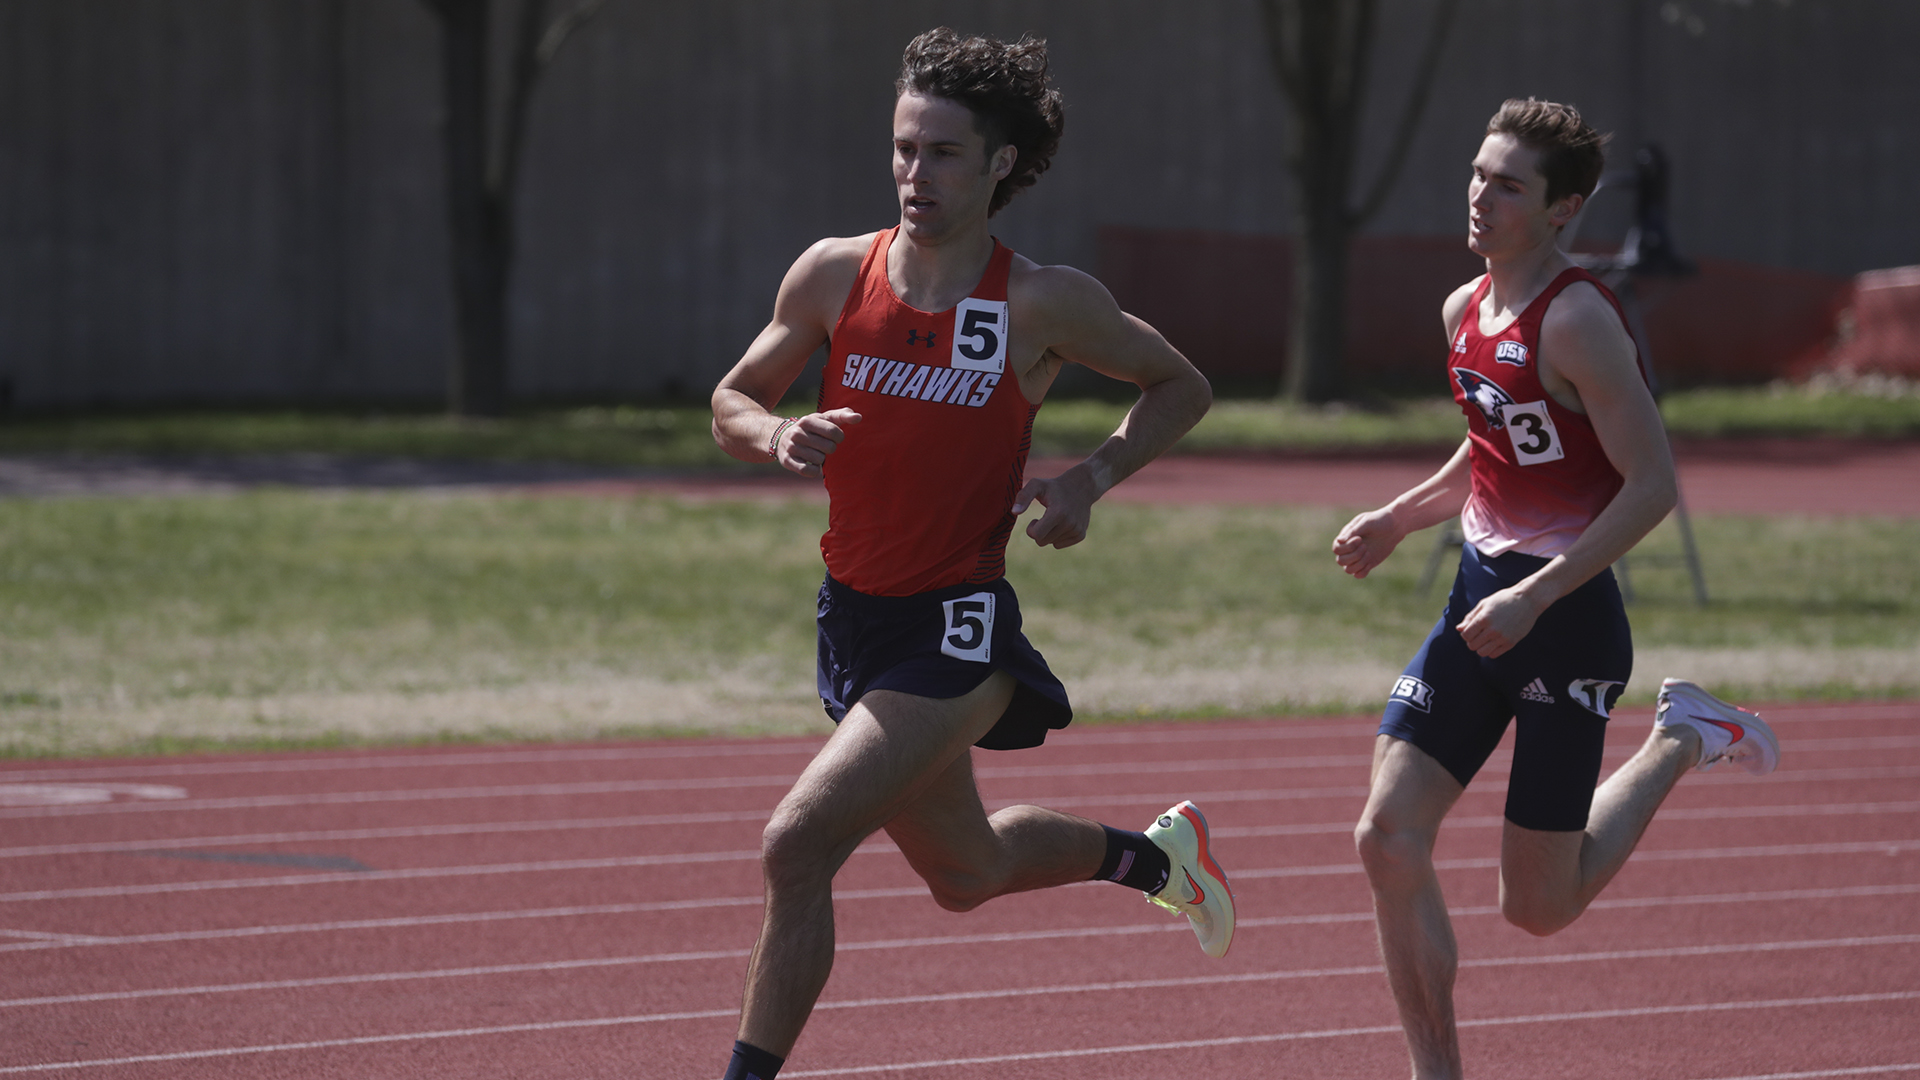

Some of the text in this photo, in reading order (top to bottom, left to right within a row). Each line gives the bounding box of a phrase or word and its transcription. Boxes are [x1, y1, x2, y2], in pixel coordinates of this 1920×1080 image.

[958, 309, 998, 360] 5
[1497, 342, 1528, 362] USI
[841, 353, 1002, 408] SKYHAWKS
[1510, 413, 1551, 455] 3
[947, 601, 985, 650] 5
[1520, 690, 1555, 704] adidas
